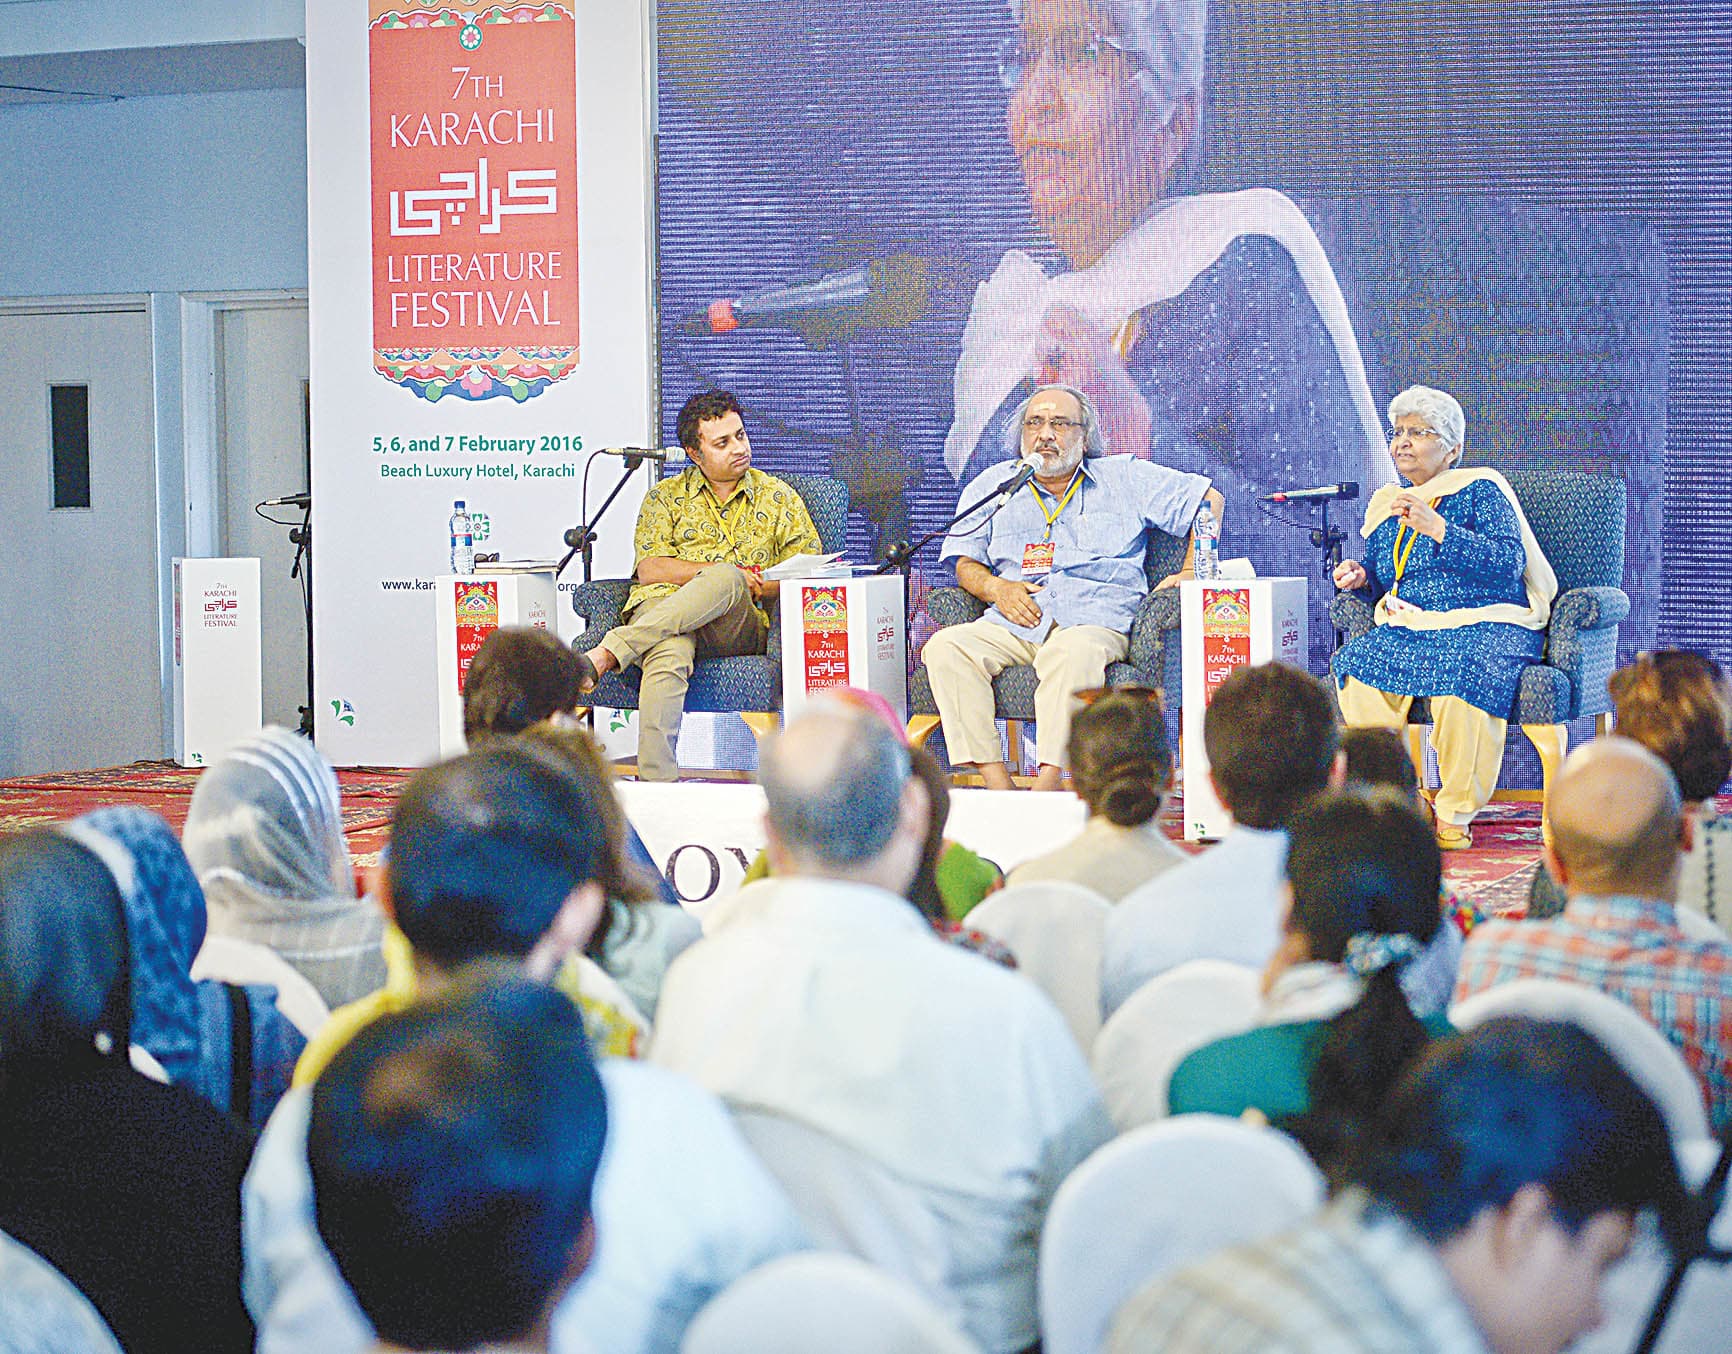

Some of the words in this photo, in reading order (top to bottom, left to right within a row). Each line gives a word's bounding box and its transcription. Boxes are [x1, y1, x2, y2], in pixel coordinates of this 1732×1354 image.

[451, 66, 504, 100] 7TH
[390, 108, 555, 148] KARACHI
[387, 251, 562, 284] LITERATURE
[390, 289, 562, 328] FESTIVAL
[408, 435, 440, 451] and
[444, 436, 454, 451] 7
[459, 435, 536, 455] February
[540, 435, 583, 451] 2016
[381, 463, 422, 477] Beach
[425, 464, 473, 480] Luxury
[476, 463, 519, 480] Hotel,
[523, 463, 576, 477] Karachi
[808, 650, 845, 658] KARACHI
[1207, 654, 1247, 664] KARACHI
